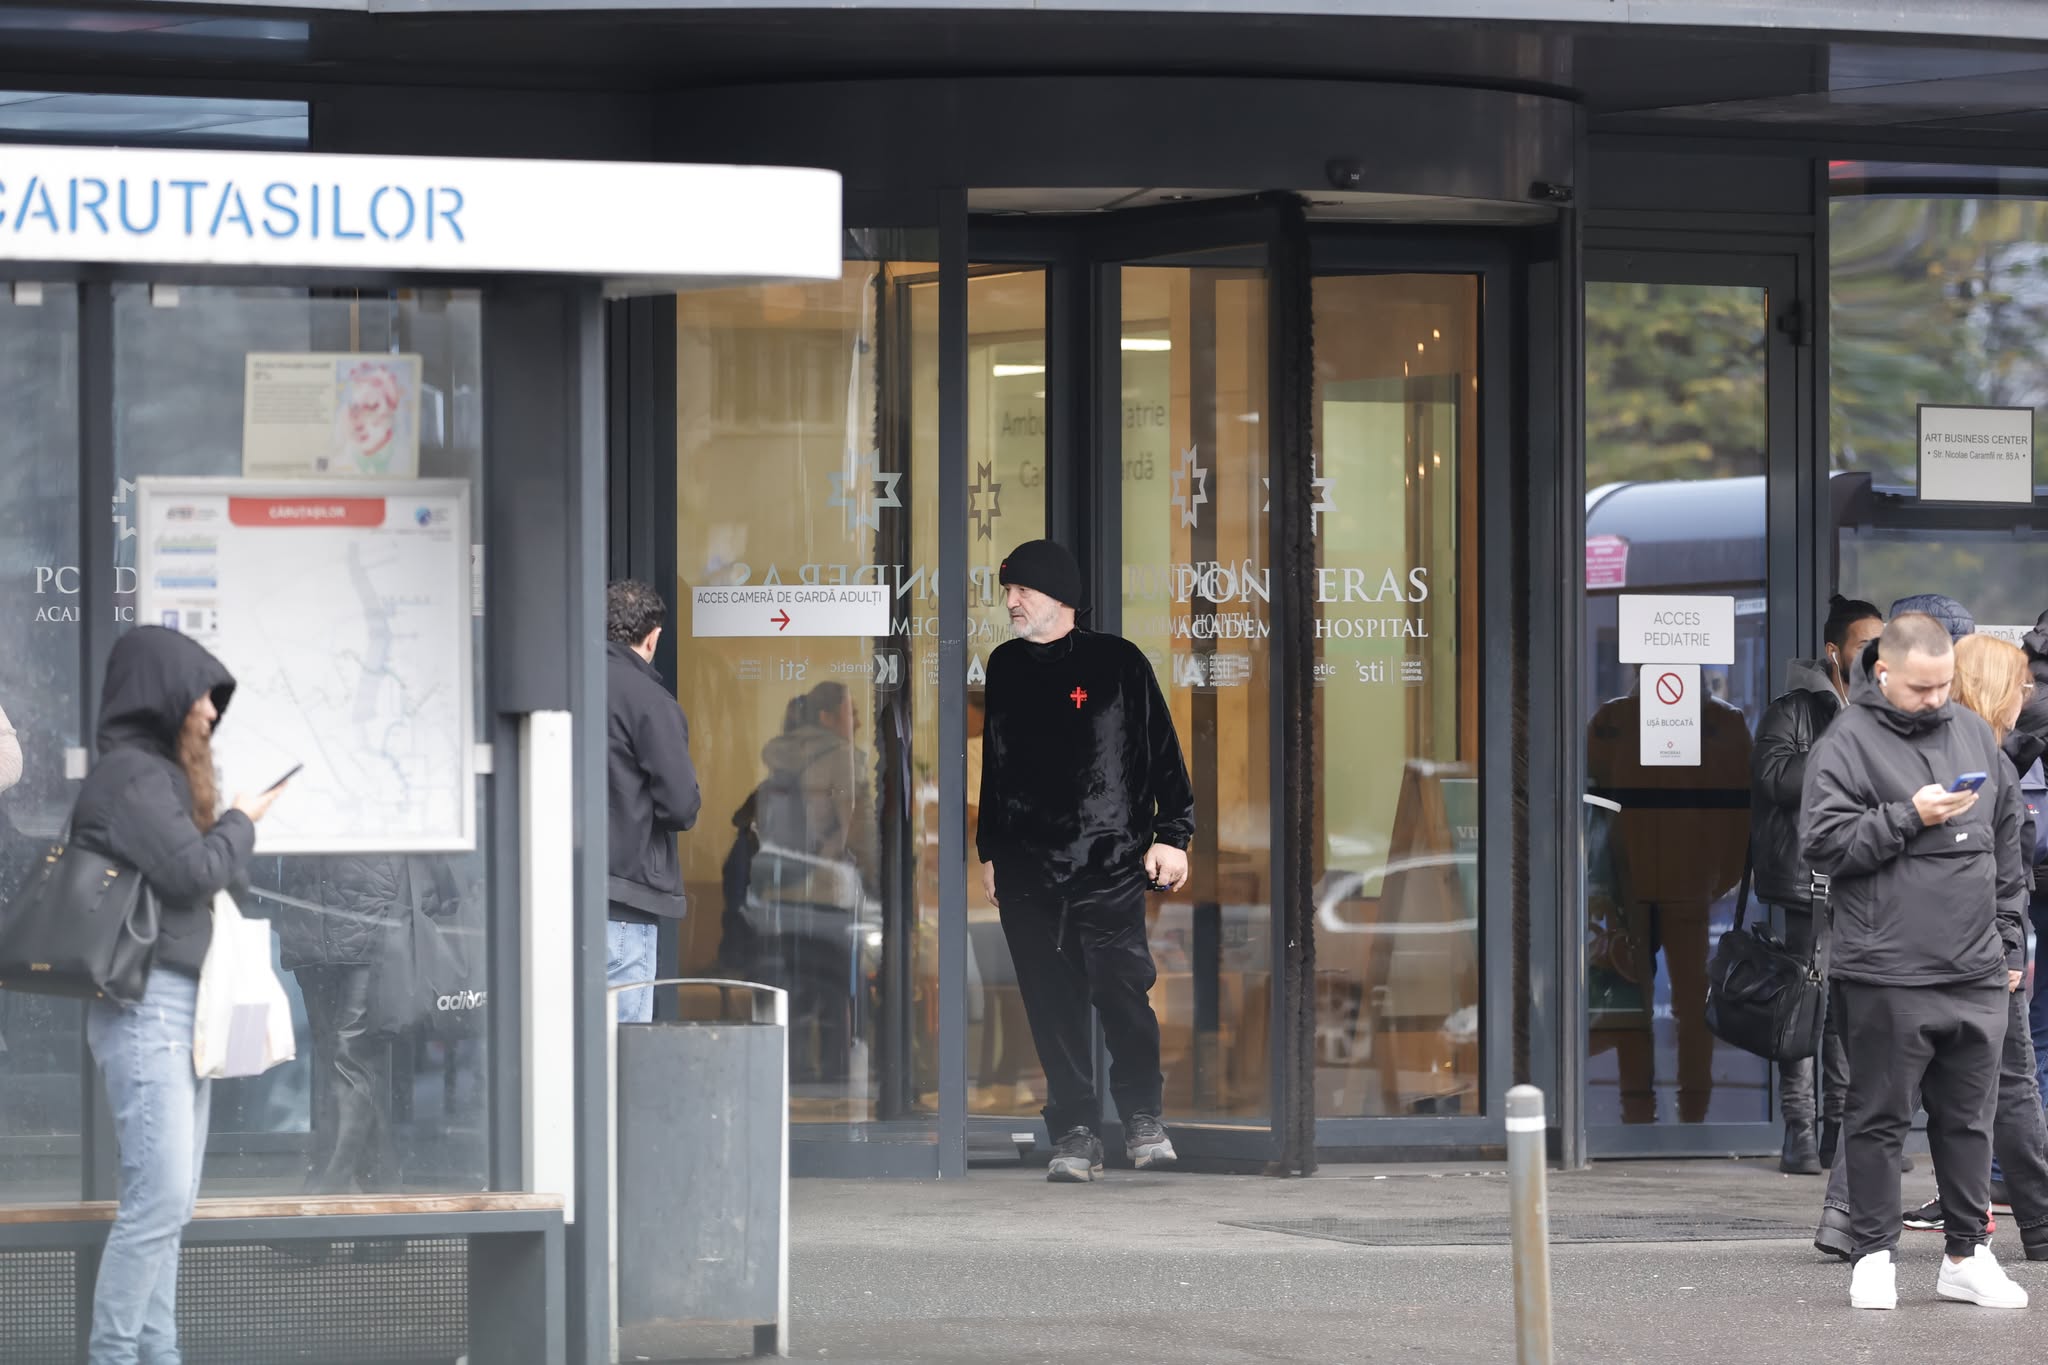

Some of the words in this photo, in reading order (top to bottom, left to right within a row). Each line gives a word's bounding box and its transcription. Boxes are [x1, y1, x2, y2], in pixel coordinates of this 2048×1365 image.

[0, 175, 466, 242] ARUTASILOR
[1925, 433, 1942, 443] ART
[1944, 434, 1990, 444] BUSINESS
[1991, 435, 2028, 445] CENTER
[1932, 450, 1944, 458] Str.
[1945, 450, 1968, 459] Nicolae
[697, 592, 729, 604] ACCES
[731, 589, 774, 604] CAMERĂ
[777, 591, 792, 603] DE
[794, 589, 836, 603] GARDĂ
[1653, 611, 1701, 626] ACCES
[1314, 617, 1429, 639] HOSPITAL
[1644, 632, 1711, 647] PEDIATRIE
[1646, 717, 1660, 728] UȘĂ
[1661, 717, 1694, 727] BLOCATĂ
